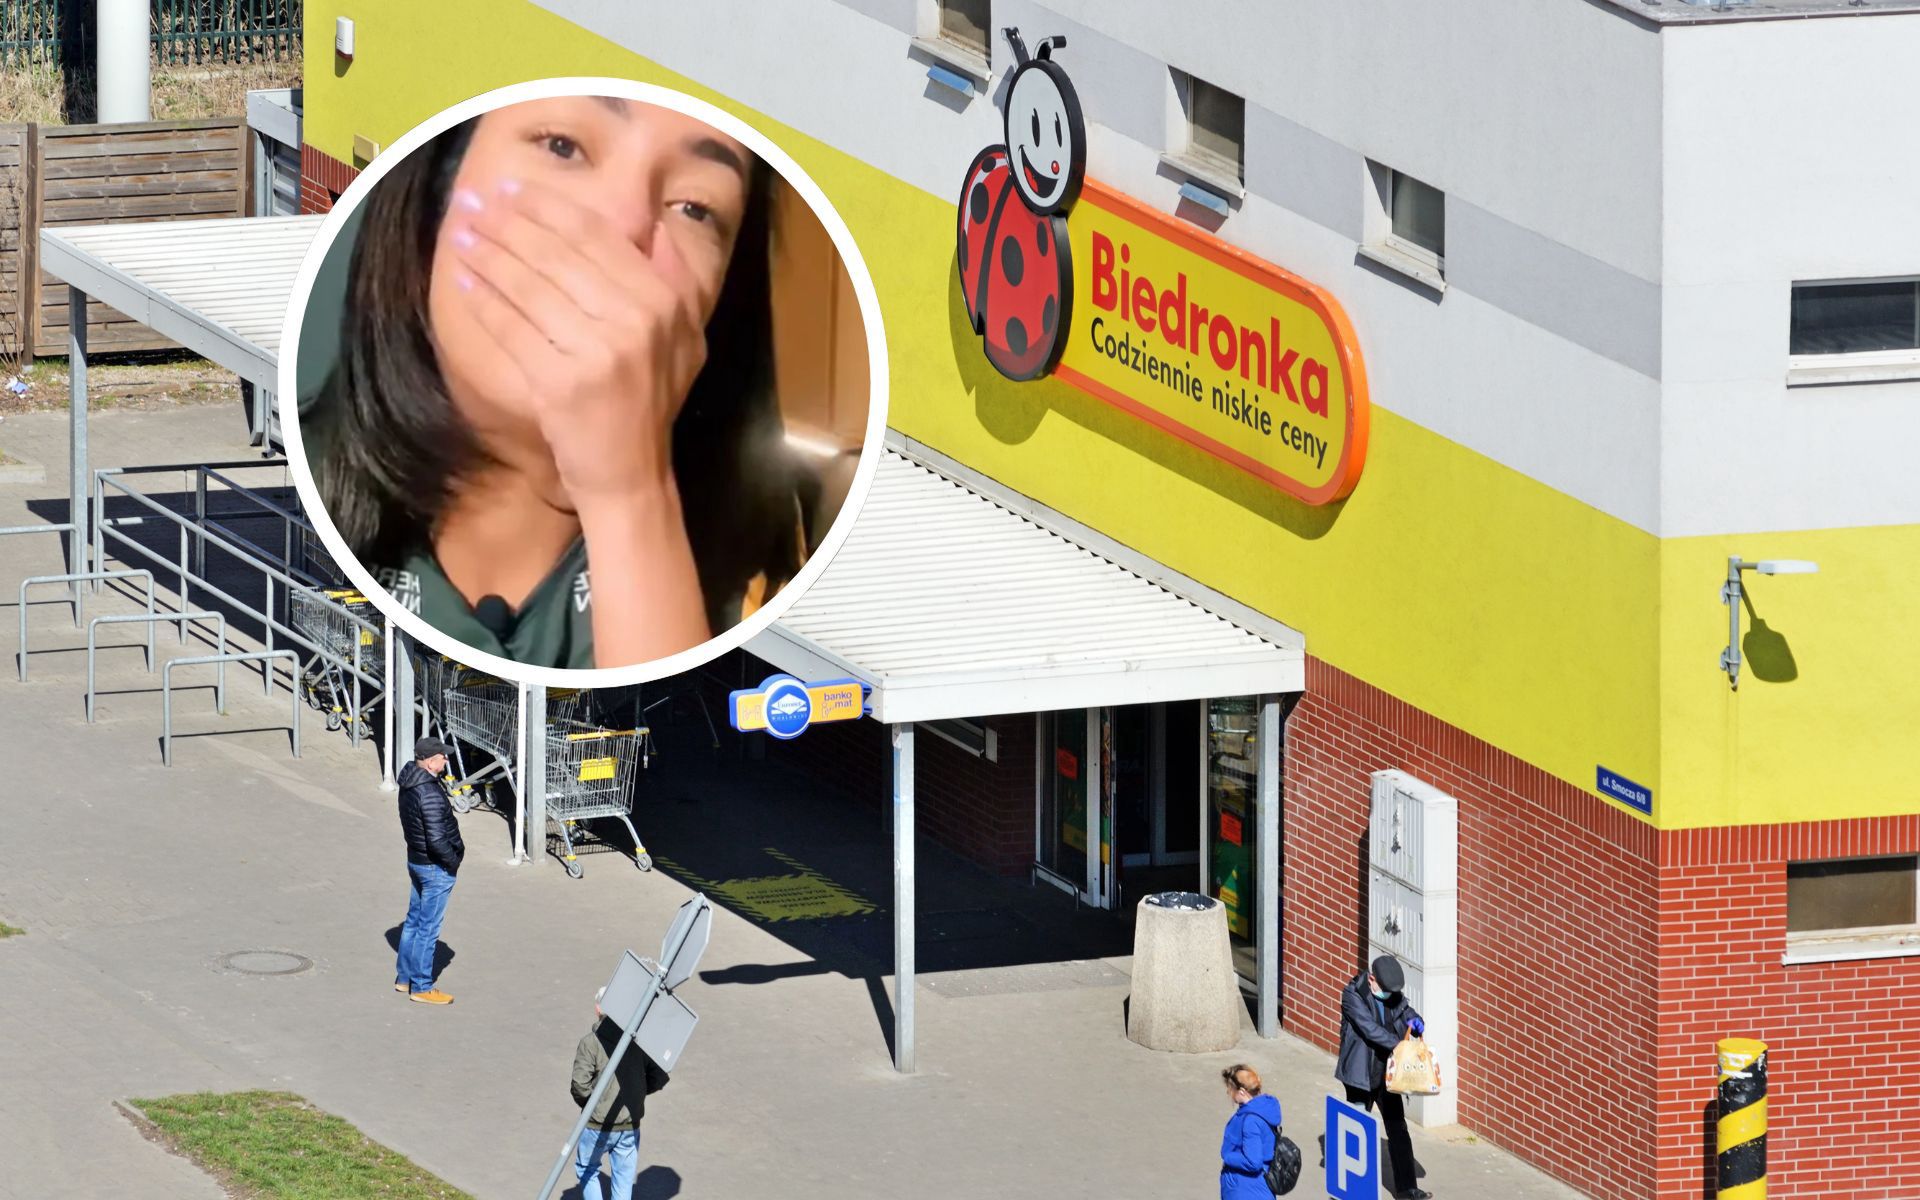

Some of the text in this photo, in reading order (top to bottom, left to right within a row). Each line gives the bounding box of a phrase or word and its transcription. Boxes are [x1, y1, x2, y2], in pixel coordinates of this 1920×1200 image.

[1092, 230, 1328, 419] Biedronka
[1091, 317, 1328, 470] Codziennie niskie ceny
[824, 691, 852, 701] banko
[834, 699, 852, 708] mat
[1602, 776, 1611, 788] ul.
[1611, 779, 1635, 800] Smocza
[1338, 1112, 1368, 1192] P
